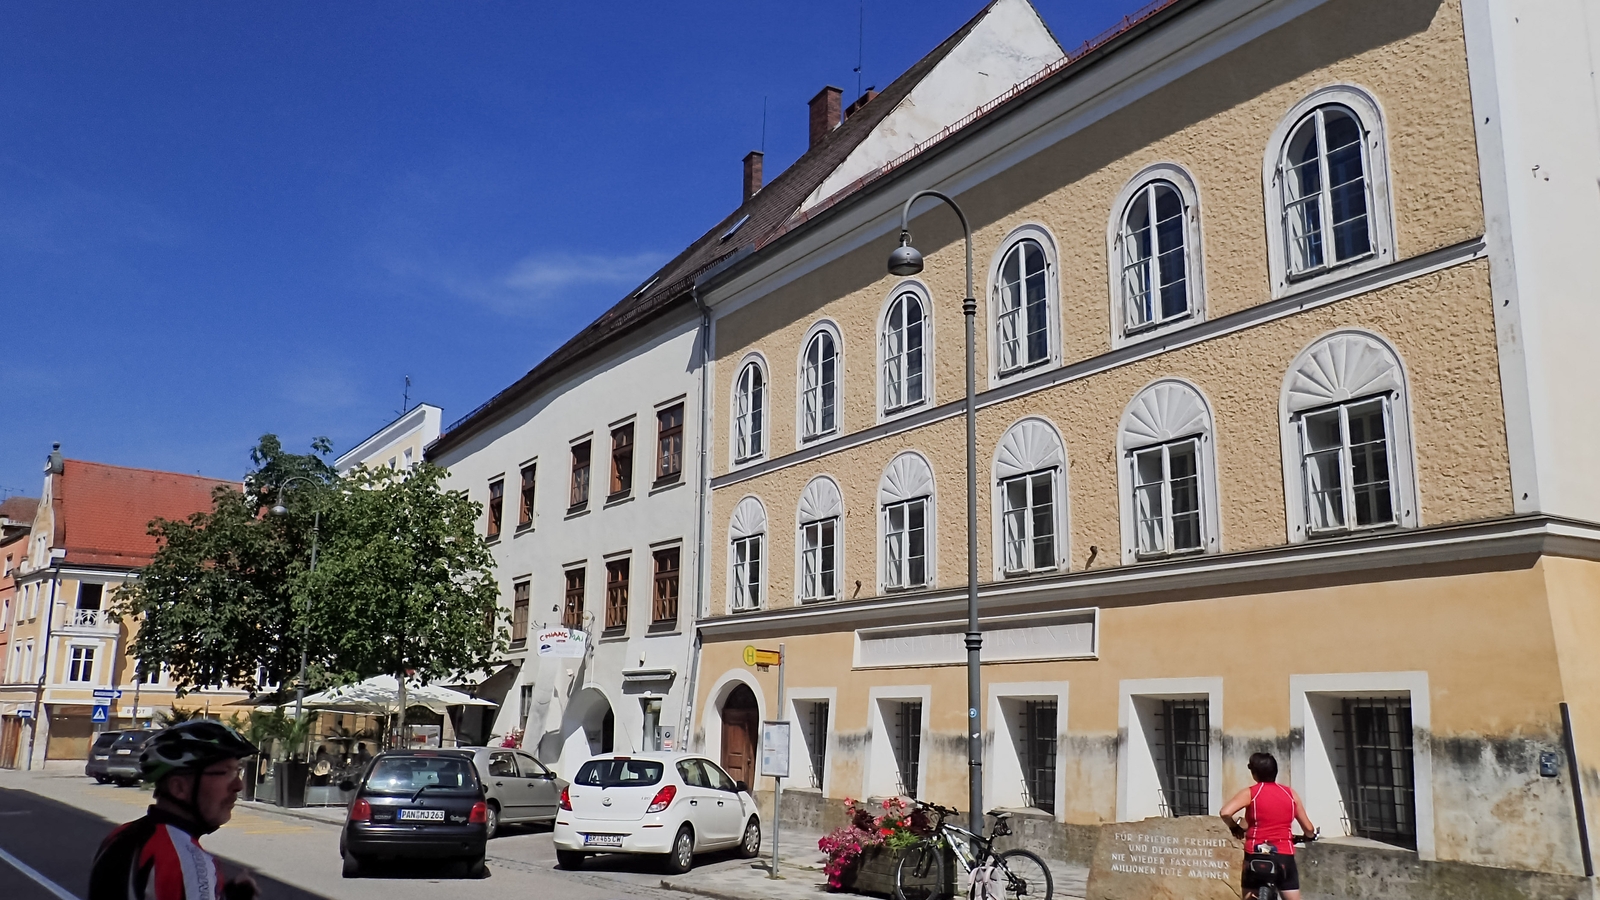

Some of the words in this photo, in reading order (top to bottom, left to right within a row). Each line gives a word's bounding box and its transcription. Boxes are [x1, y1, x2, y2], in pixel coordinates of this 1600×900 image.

[746, 649, 755, 662] H
[402, 810, 416, 819] PAN
[430, 811, 444, 820] 263
[1137, 833, 1179, 845] FRIEDEN
[1184, 837, 1227, 848] FREIHEIT
[1128, 844, 1148, 853] UND
[1151, 846, 1213, 858] DEMOKRATIE
[1111, 853, 1126, 862] NIE
[1130, 854, 1165, 866] WIEDER
[1170, 857, 1230, 870] FASCHISMUS
[1111, 863, 1156, 875] MILLIONEN
[1159, 866, 1182, 877] TOTE
[1188, 869, 1230, 881] MAHNEN
